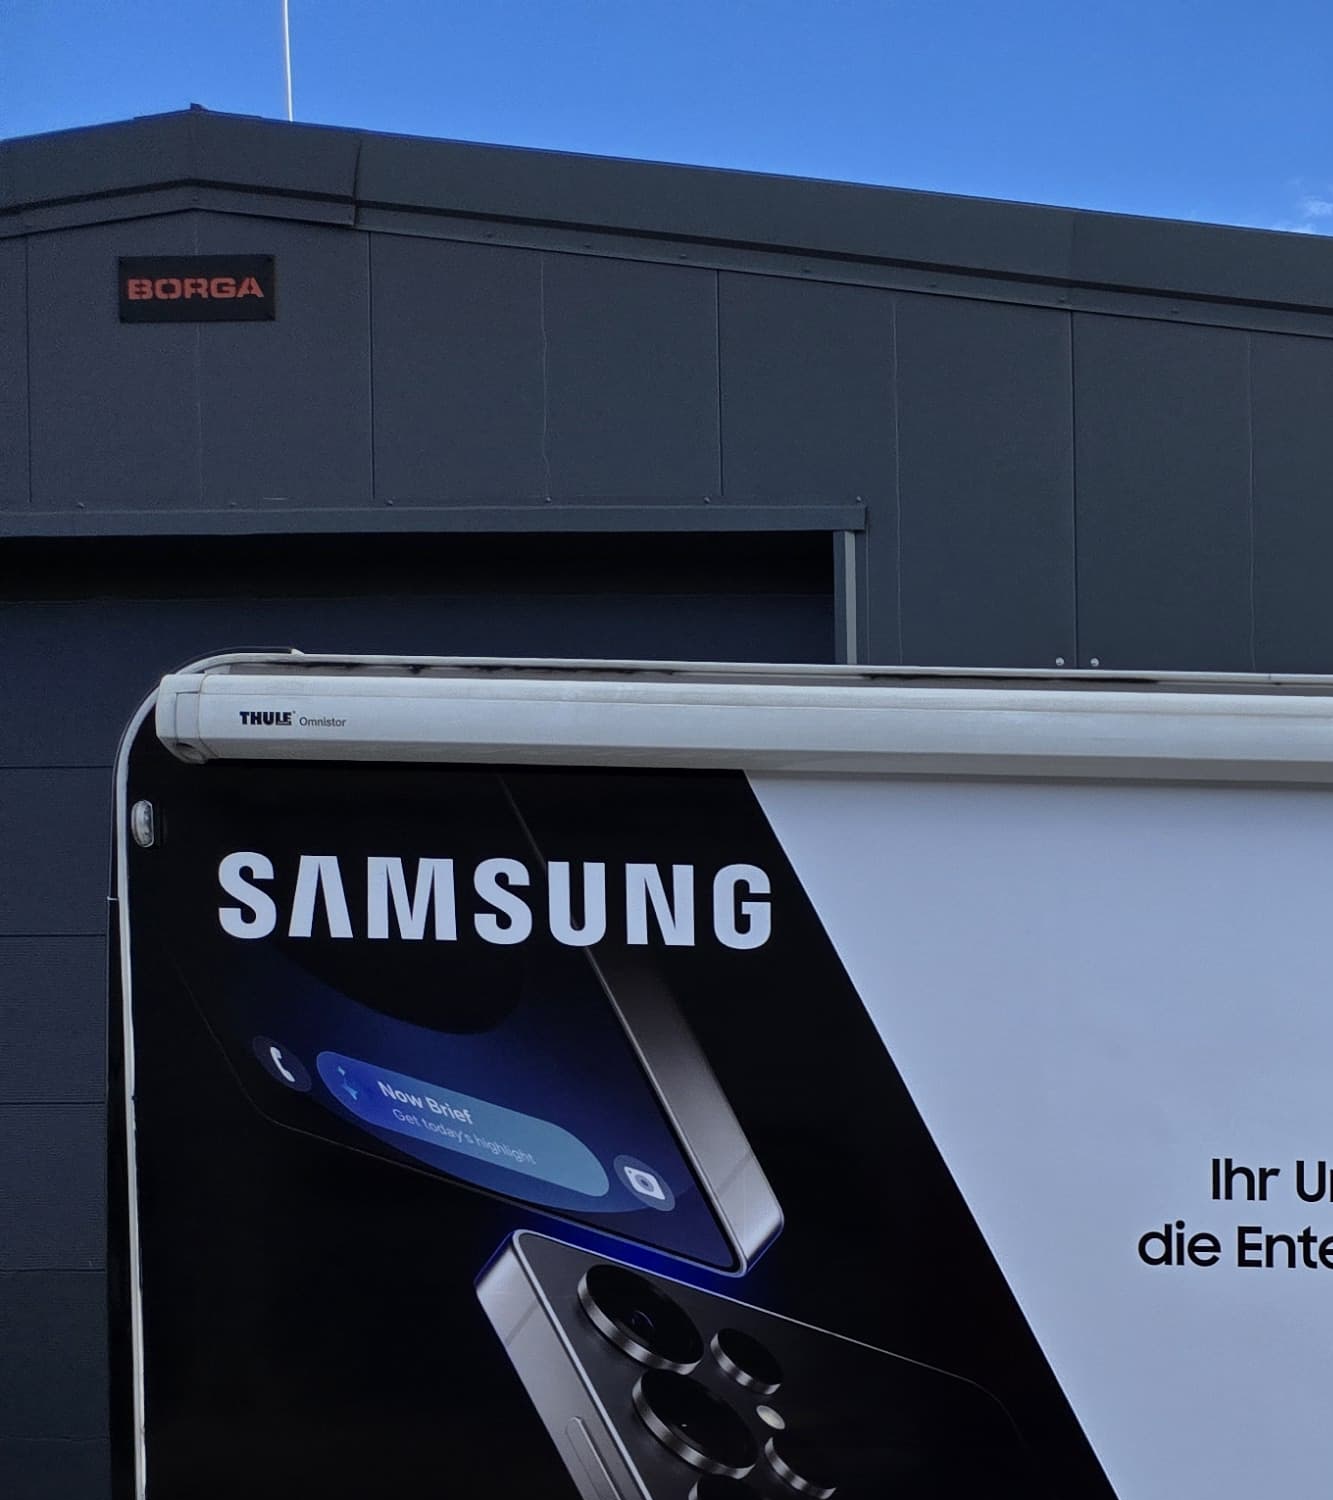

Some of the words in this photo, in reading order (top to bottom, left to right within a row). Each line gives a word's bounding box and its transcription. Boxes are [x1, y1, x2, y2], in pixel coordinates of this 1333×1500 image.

[127, 276, 265, 301] BORGA
[239, 711, 293, 726] THULE
[299, 716, 347, 727] Omnistor
[218, 851, 772, 950] SAMSUNG
[377, 1080, 424, 1109] Now
[424, 1096, 473, 1125] Brief
[391, 1108, 424, 1128] Get
[1211, 1158, 1281, 1201] Ihr
[1137, 1219, 1222, 1268] die
